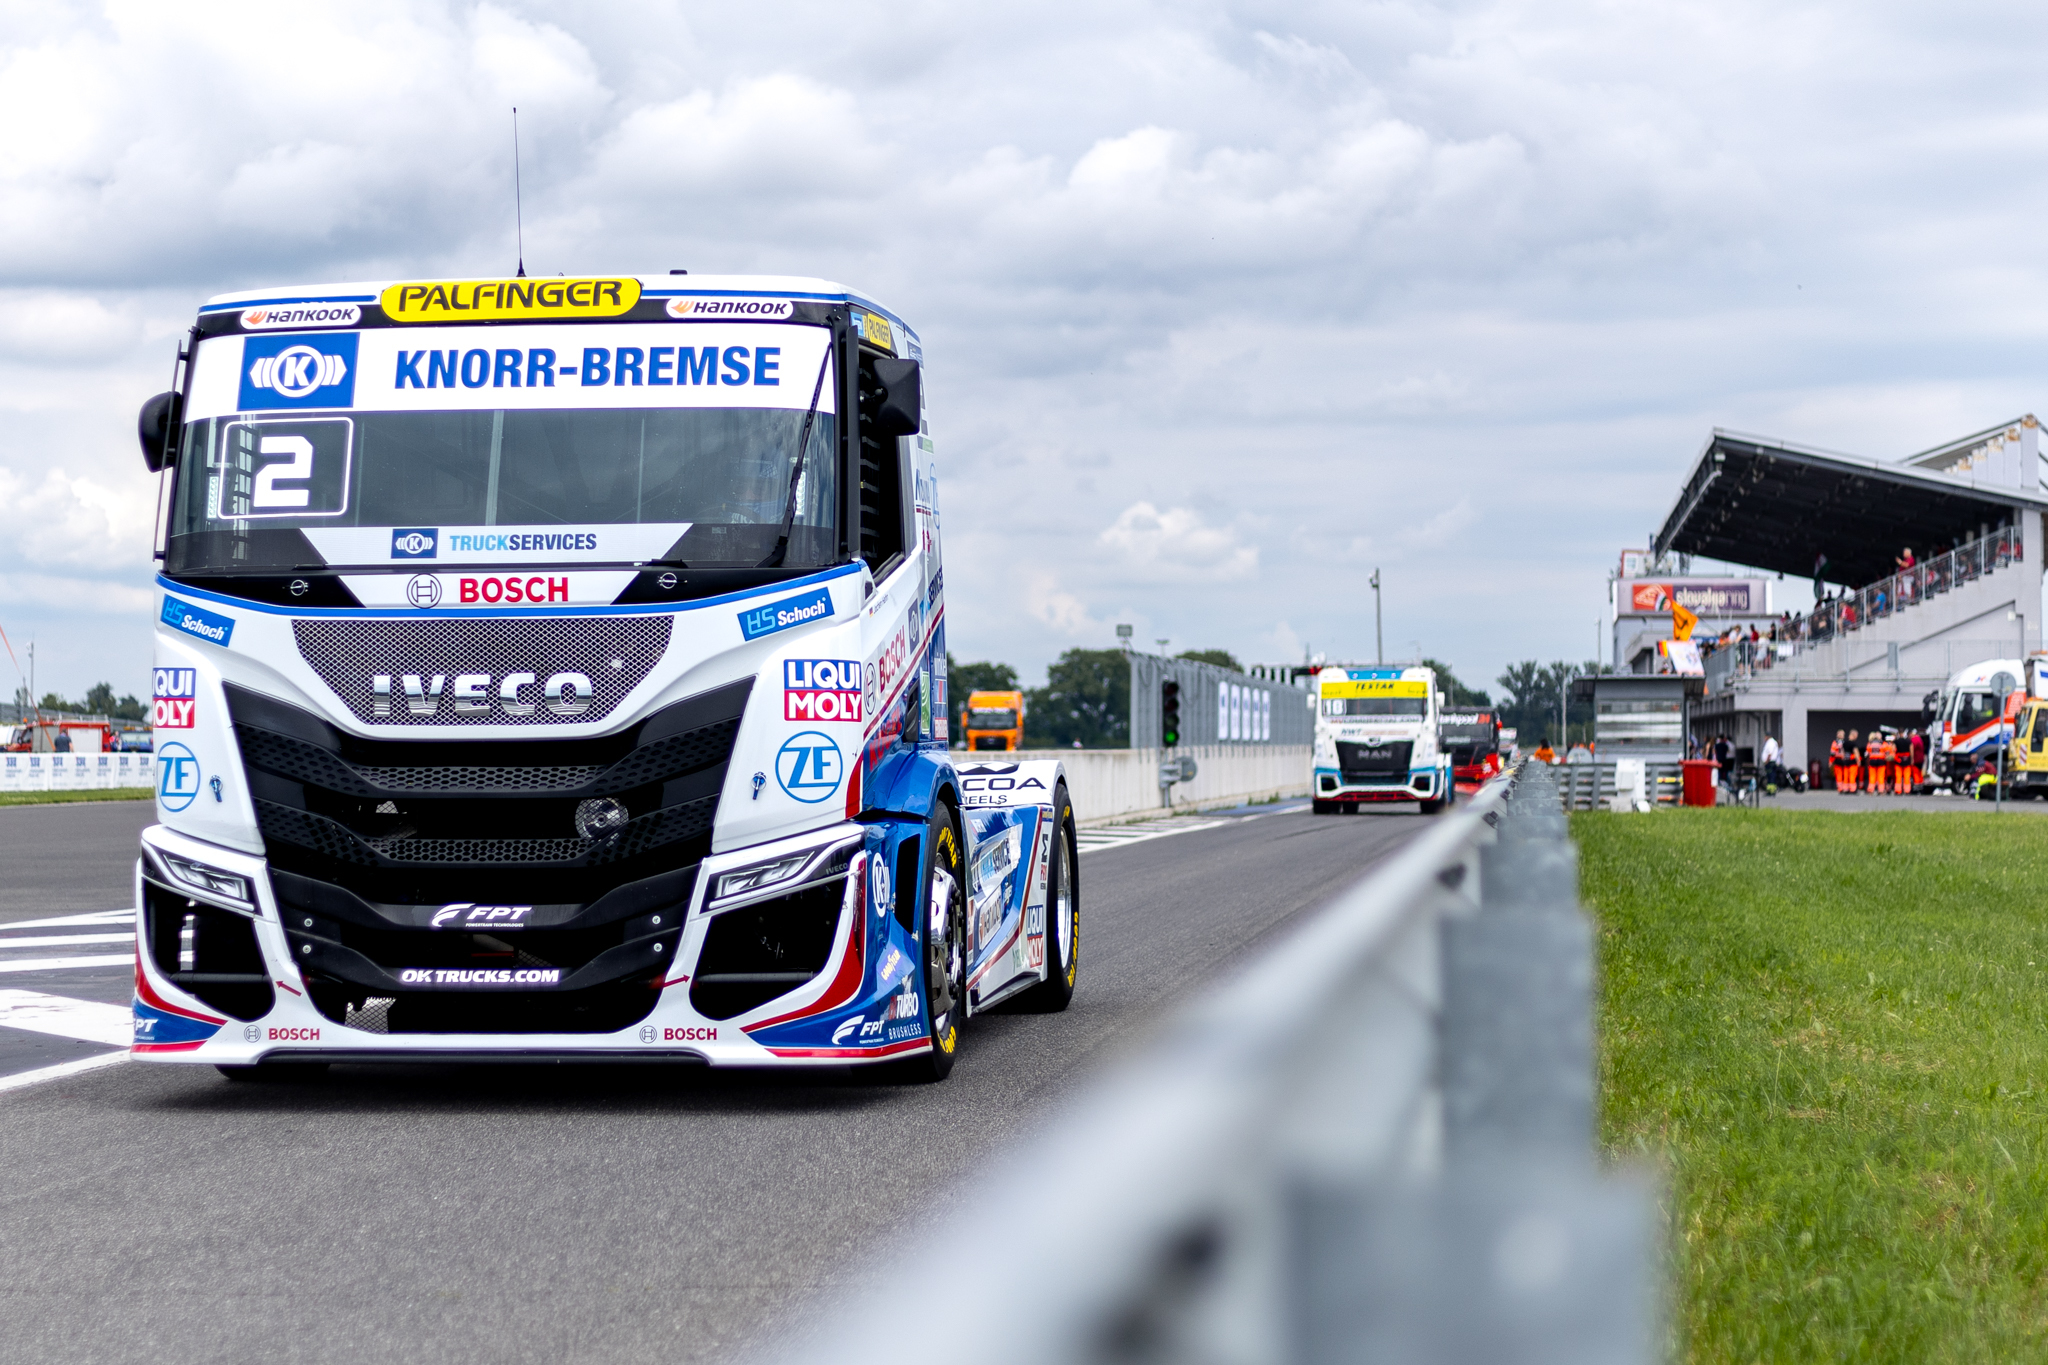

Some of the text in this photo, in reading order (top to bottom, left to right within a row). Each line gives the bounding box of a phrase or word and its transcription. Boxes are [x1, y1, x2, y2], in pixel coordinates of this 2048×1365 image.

[398, 281, 621, 313] PALFINGER
[394, 346, 780, 390] KNORR-BREMSE
[253, 435, 314, 508] 2
[459, 576, 569, 603] BOSCH
[777, 600, 826, 627] Schoch
[181, 614, 225, 641] Schoch
[878, 624, 906, 694] BOSCH
[787, 660, 861, 690] LIQUI
[373, 671, 593, 718] IVECO
[788, 692, 861, 720] MOLY
[157, 756, 196, 798] ZF
[784, 746, 838, 789] ZF
[825, 862, 849, 875] IVECO
[466, 906, 533, 920] FPT
[268, 1027, 321, 1041] BOSCH
[664, 1027, 718, 1041] BOSCH
[860, 1019, 885, 1037] FPT
[888, 1022, 922, 1040] BRUSHLESS
